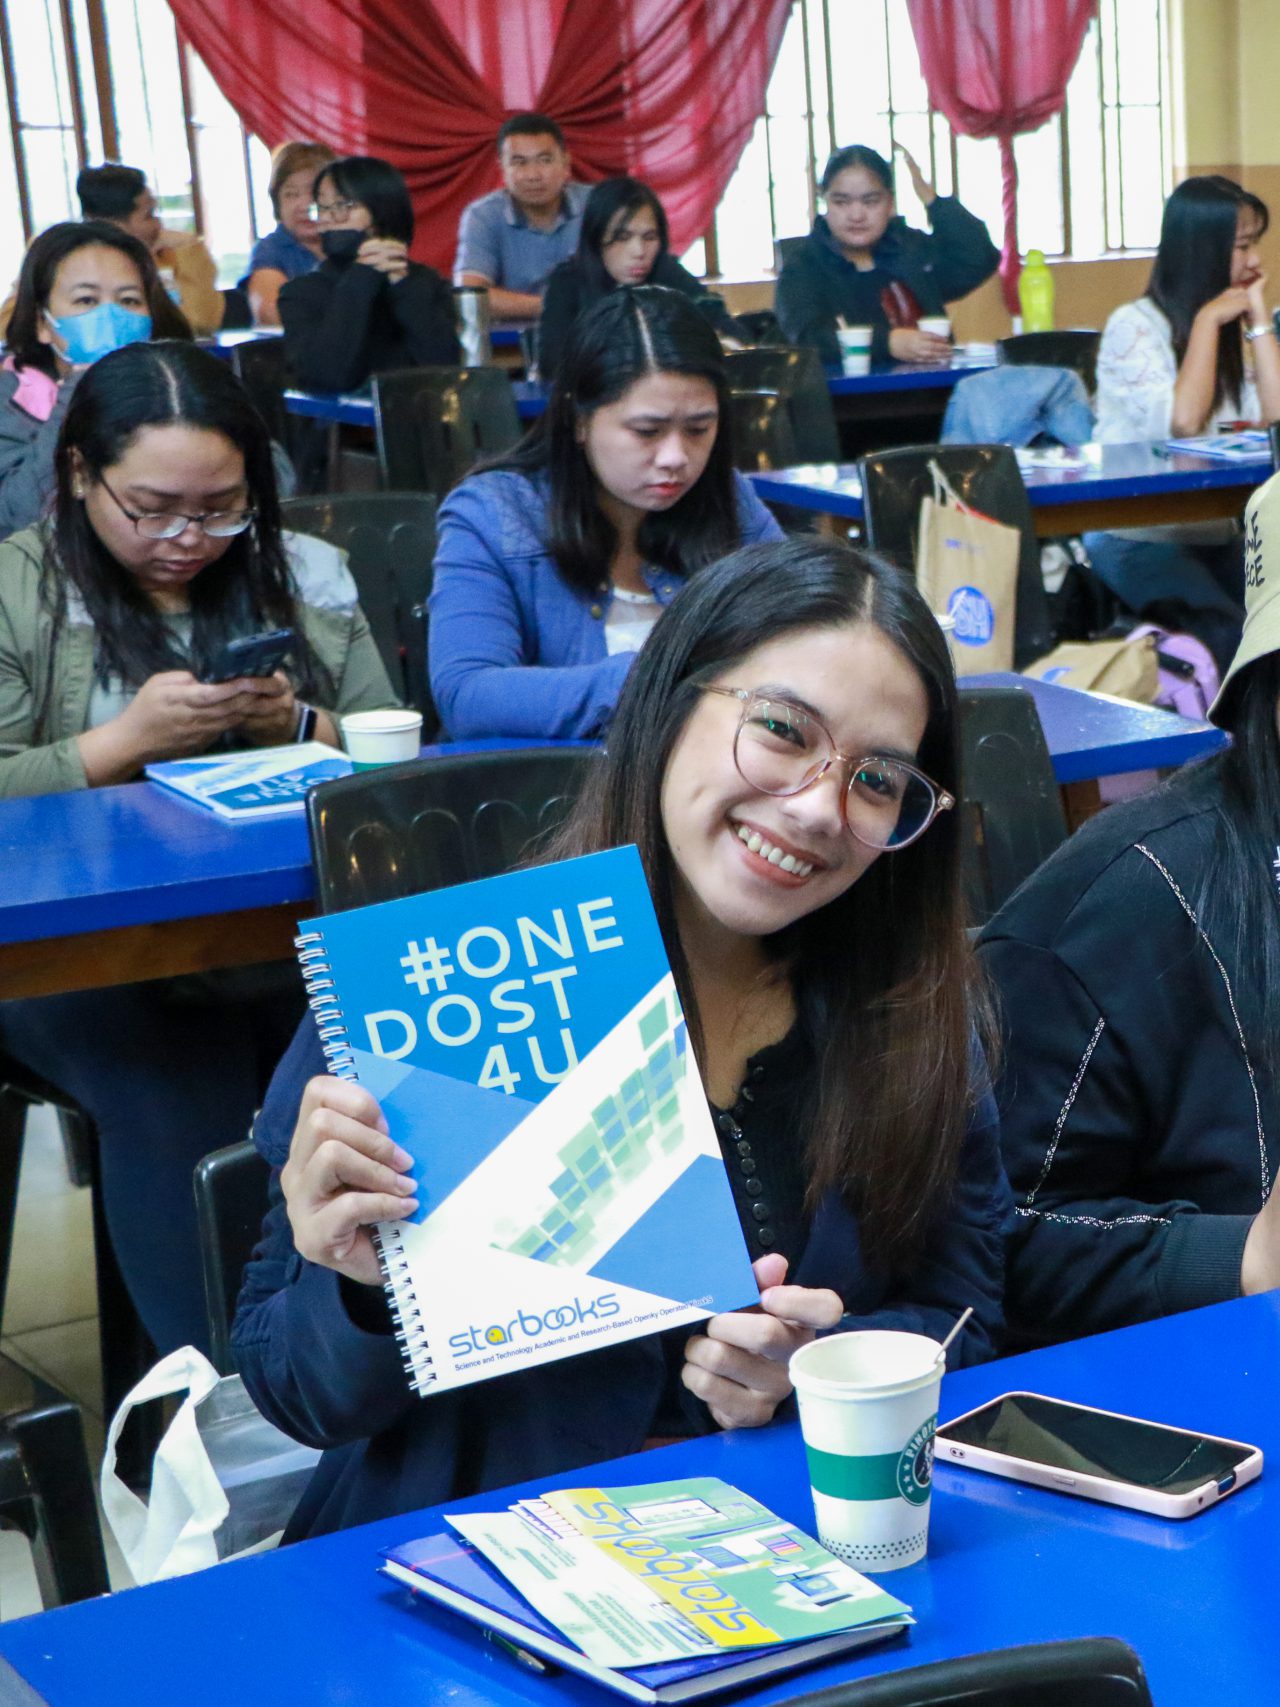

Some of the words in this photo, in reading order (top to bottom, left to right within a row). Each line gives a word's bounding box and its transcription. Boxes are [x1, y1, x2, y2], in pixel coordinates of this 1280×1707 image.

[400, 897, 625, 996] #ONE
[364, 966, 578, 1061] DOST
[476, 1028, 579, 1096] 4U
[448, 1293, 620, 1358] starbooks
[454, 1358, 481, 1371] Science
[481, 1354, 494, 1363] and
[495, 1344, 533, 1361] Technology
[533, 1335, 566, 1350] Academic
[567, 1331, 579, 1341] and
[580, 1317, 632, 1337] Research-Based
